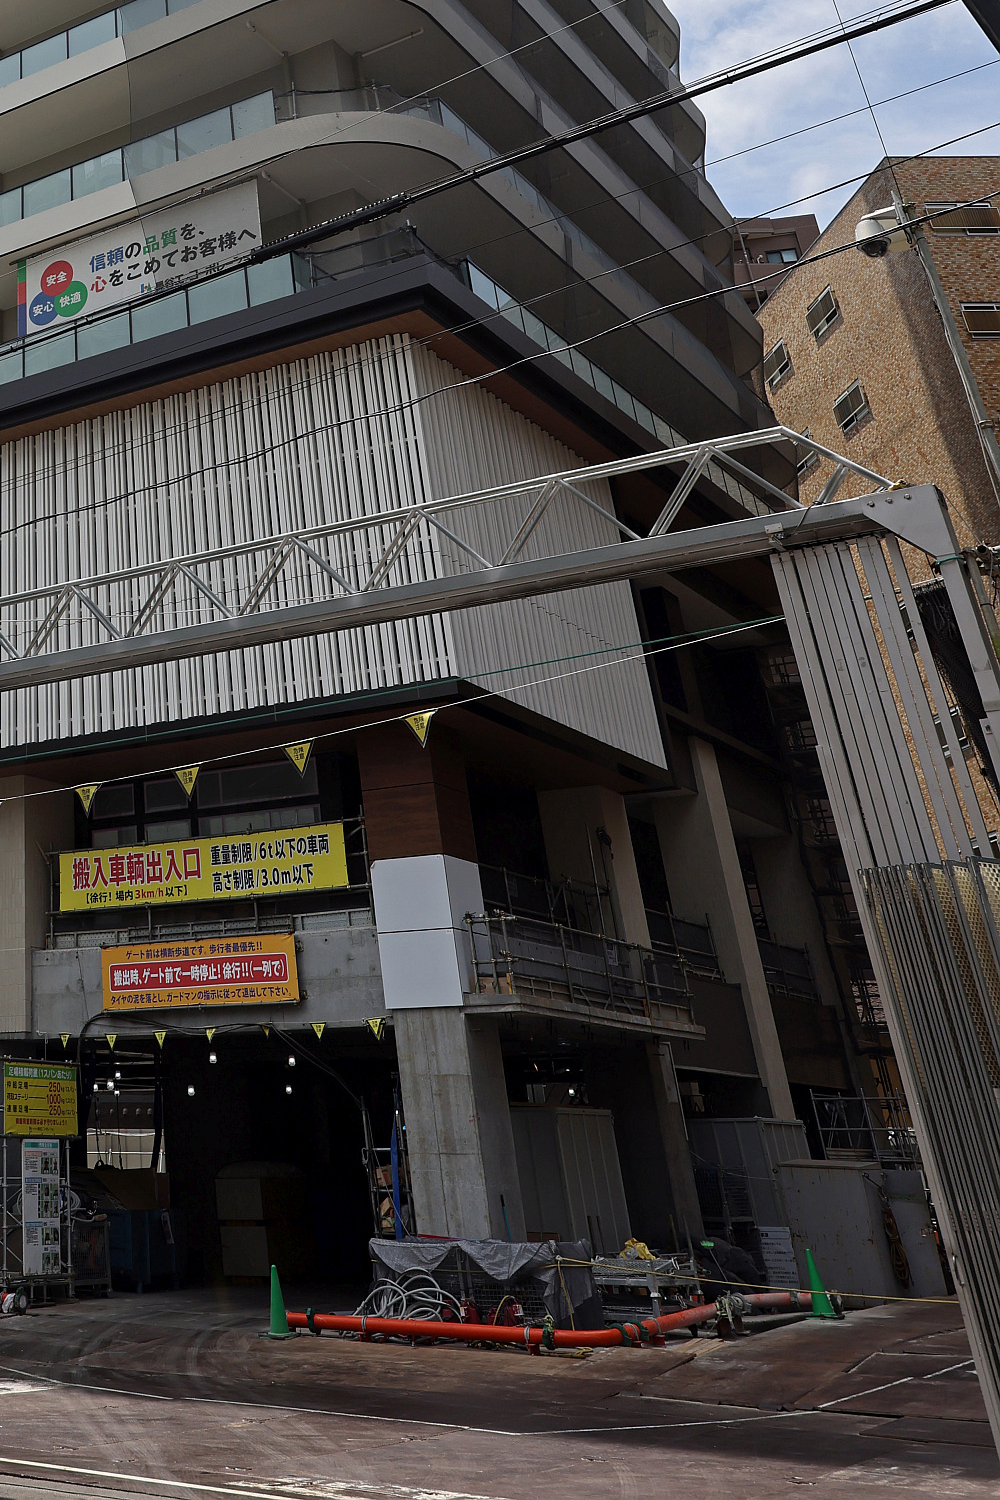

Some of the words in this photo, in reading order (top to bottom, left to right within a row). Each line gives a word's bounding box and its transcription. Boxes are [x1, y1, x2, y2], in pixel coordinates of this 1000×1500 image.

[89, 223, 205, 274] 信頼の品質を、
[91, 228, 257, 293] 心をこめてお客様へ
[45, 269, 68, 287] 安全
[59, 290, 82, 307] 快適
[32, 300, 54, 317] 安心
[210, 833, 330, 866] 重量制限/6t以下の車両
[212, 863, 314, 893] 高さ制限/3.0m以下
[48, 1081, 62, 1093] 250
[46, 1094, 62, 1104] 1000
[48, 1105, 62, 1116] 250
